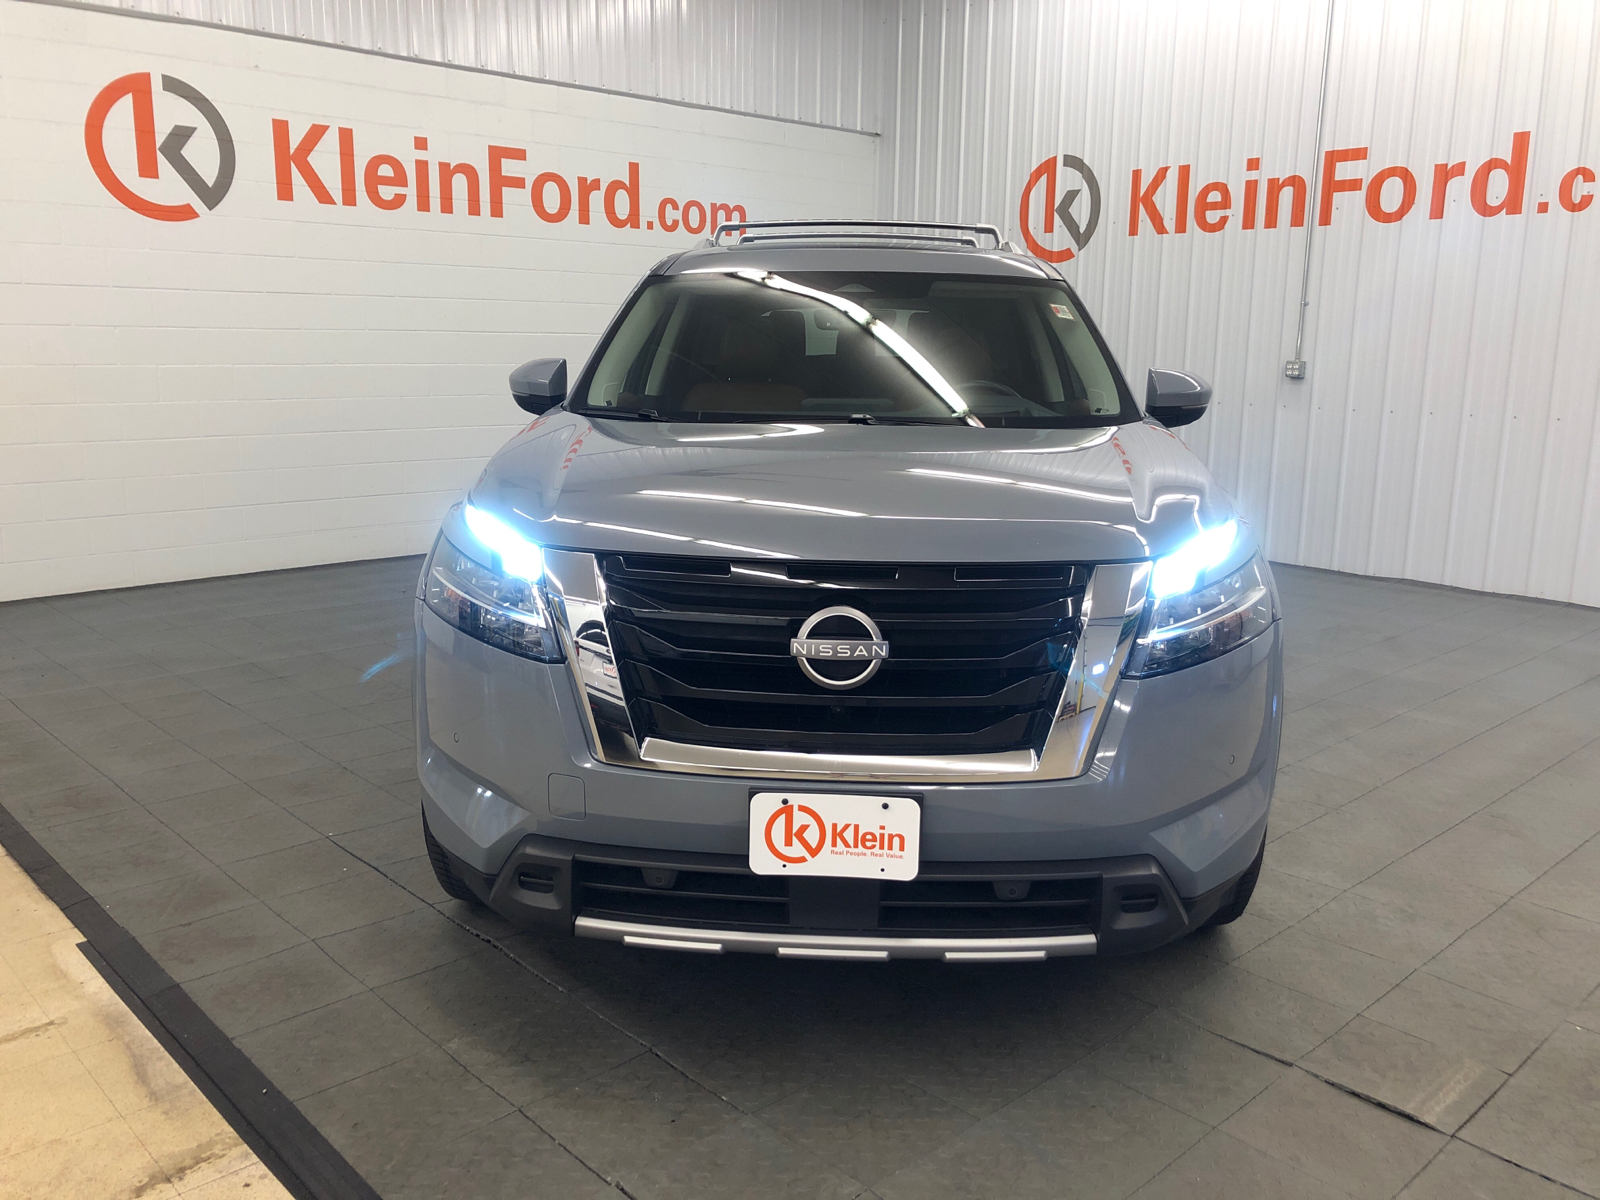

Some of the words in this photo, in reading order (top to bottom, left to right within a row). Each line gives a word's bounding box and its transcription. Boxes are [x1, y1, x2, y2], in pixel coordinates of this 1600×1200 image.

[271, 118, 747, 237] KleinFord.com
[793, 642, 886, 657] NISSAN
[831, 822, 906, 852] Klein
